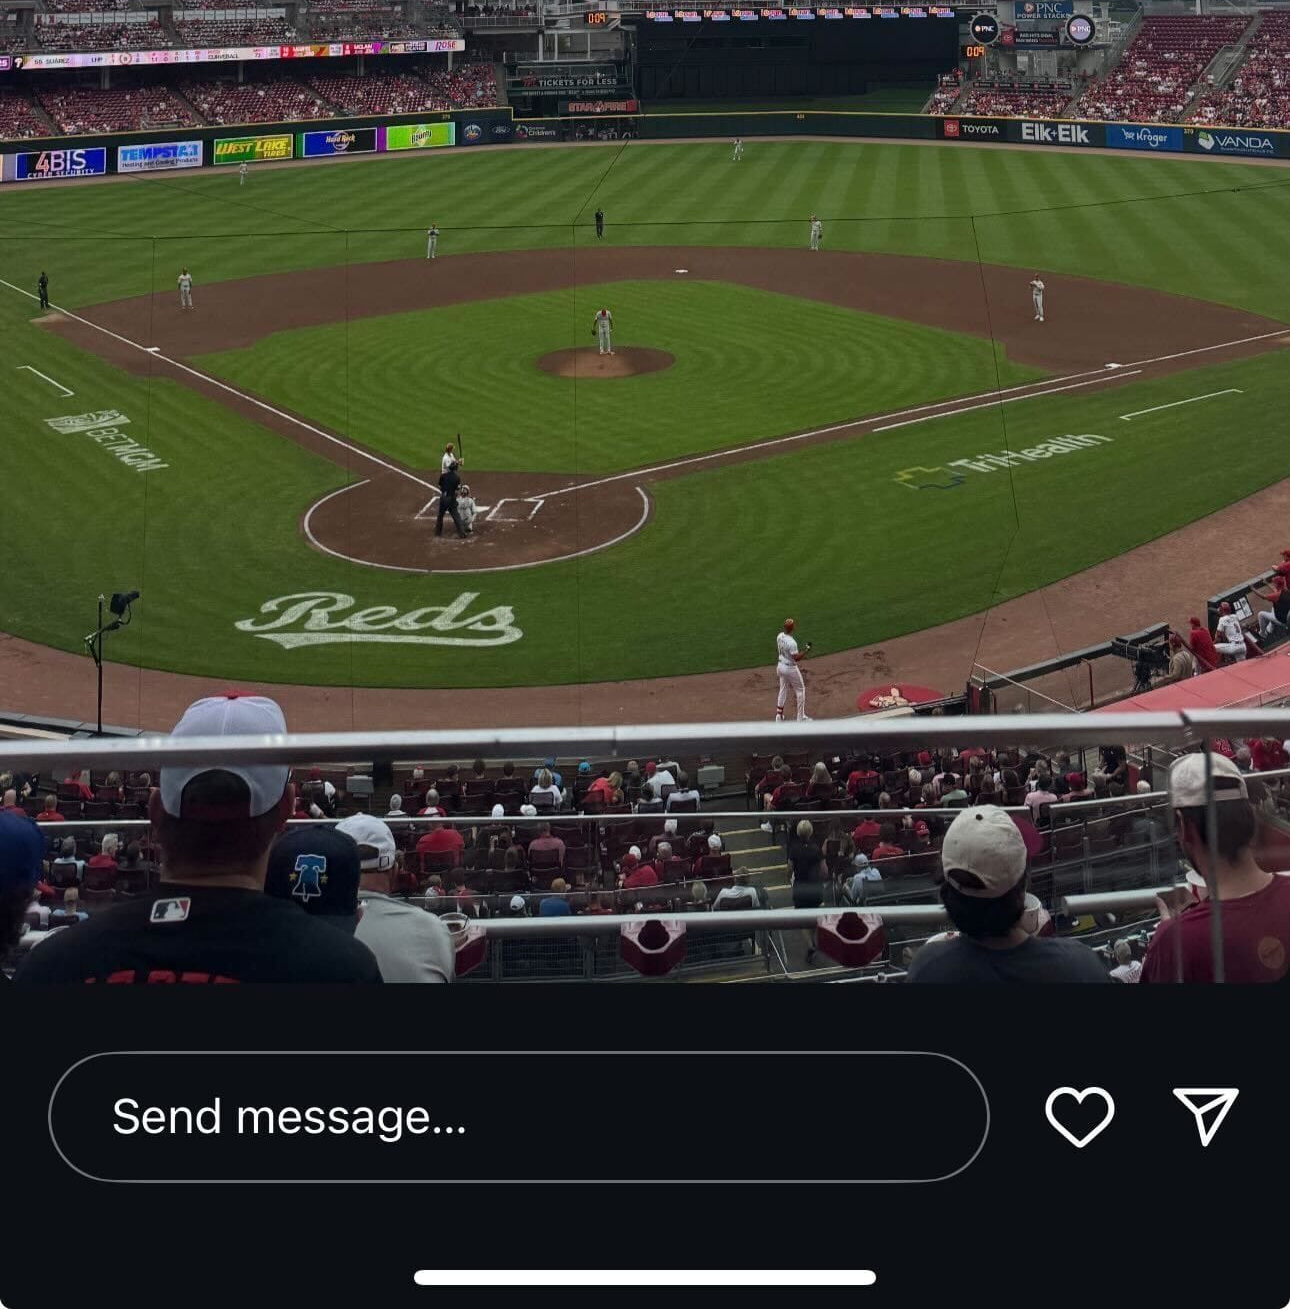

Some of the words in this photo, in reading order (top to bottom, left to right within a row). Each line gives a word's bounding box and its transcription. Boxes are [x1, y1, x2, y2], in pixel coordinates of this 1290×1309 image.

[1036, 2, 1063, 13] PNC
[539, 79, 574, 87] TICKETS
[576, 78, 594, 86] FOR
[962, 124, 999, 134] TOYOTA
[325, 134, 340, 143] Hard
[341, 134, 356, 142] Rock
[1136, 127, 1168, 147] Kroger
[1215, 135, 1274, 149] VANDA
[216, 142, 252, 155] WEST
[255, 138, 291, 152] LAKE
[263, 149, 286, 158] TIRES
[35, 149, 87, 171] 4BIS
[948, 431, 1114, 474] TriHealth
[234, 592, 523, 646] Reds
